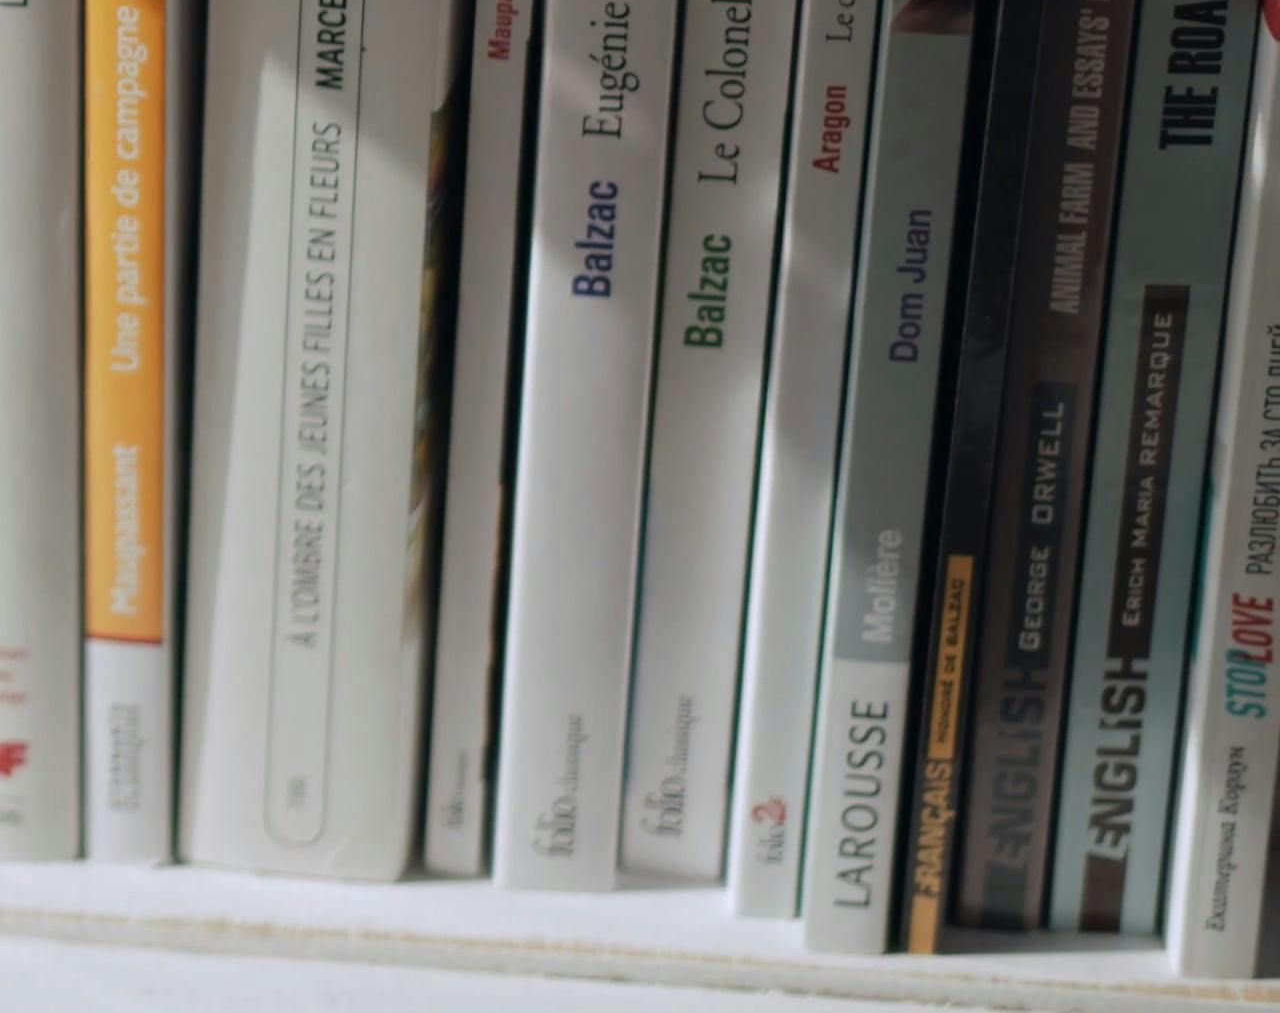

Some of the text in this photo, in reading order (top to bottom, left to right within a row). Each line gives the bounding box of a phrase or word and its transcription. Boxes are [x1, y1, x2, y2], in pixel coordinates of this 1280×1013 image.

[583, 1, 640, 140] Eugénie
[825, 12, 854, 43] Le
[115, 5, 149, 161] campagne
[812, 84, 848, 174] Aragon
[1066, 105, 1101, 151] AND
[1158, 84, 1219, 151] THE
[111, 169, 139, 209] de
[308, 121, 341, 220] FLEURS
[697, 142, 740, 186] Le
[1059, 161, 1095, 227] FARM
[111, 215, 148, 307] partie
[306, 227, 337, 263] EN
[572, 179, 619, 299] Balzac
[888, 208, 933, 364] Dom Juan
[1050, 229, 1088, 316] ANIMAL
[302, 271, 335, 353] FILLES
[684, 234, 732, 349] Balzac
[110, 311, 139, 373] Une
[1139, 311, 1175, 466] REMARQUE
[297, 360, 330, 456] JEUNES
[108, 443, 146, 617] Maupassant
[294, 462, 327, 513] DES
[1019, 401, 1065, 653] GEORGE ORWELL
[1245, 459, 1280, 576] РАЗЛЮБИТЬ
[861, 528, 904, 644] Molière
[833, 698, 891, 910] LAROUSSE
